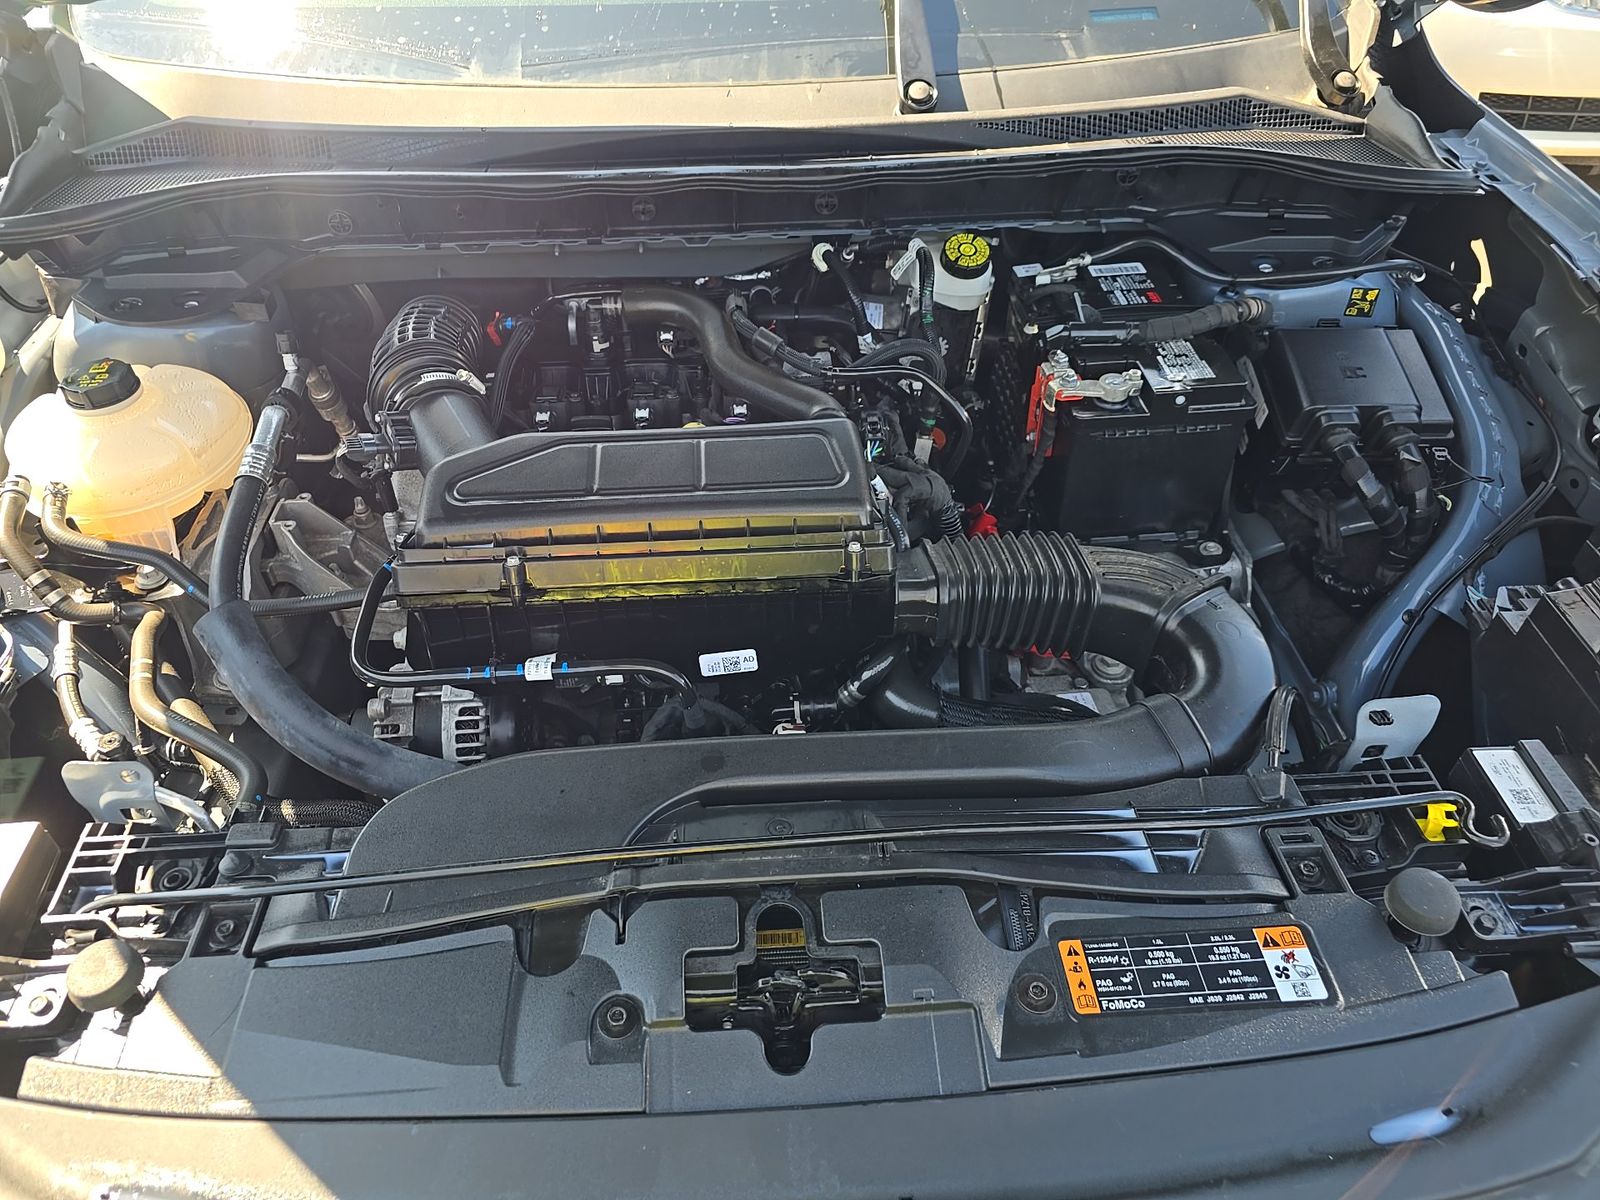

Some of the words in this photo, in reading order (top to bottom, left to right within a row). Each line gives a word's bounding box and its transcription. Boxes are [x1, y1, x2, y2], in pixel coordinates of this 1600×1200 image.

[1166, 950, 1175, 958] kg
[1088, 955, 1119, 964] R-1234yf
[1096, 979, 1113, 987] PAG
[1102, 999, 1145, 1010] FoMoCo
